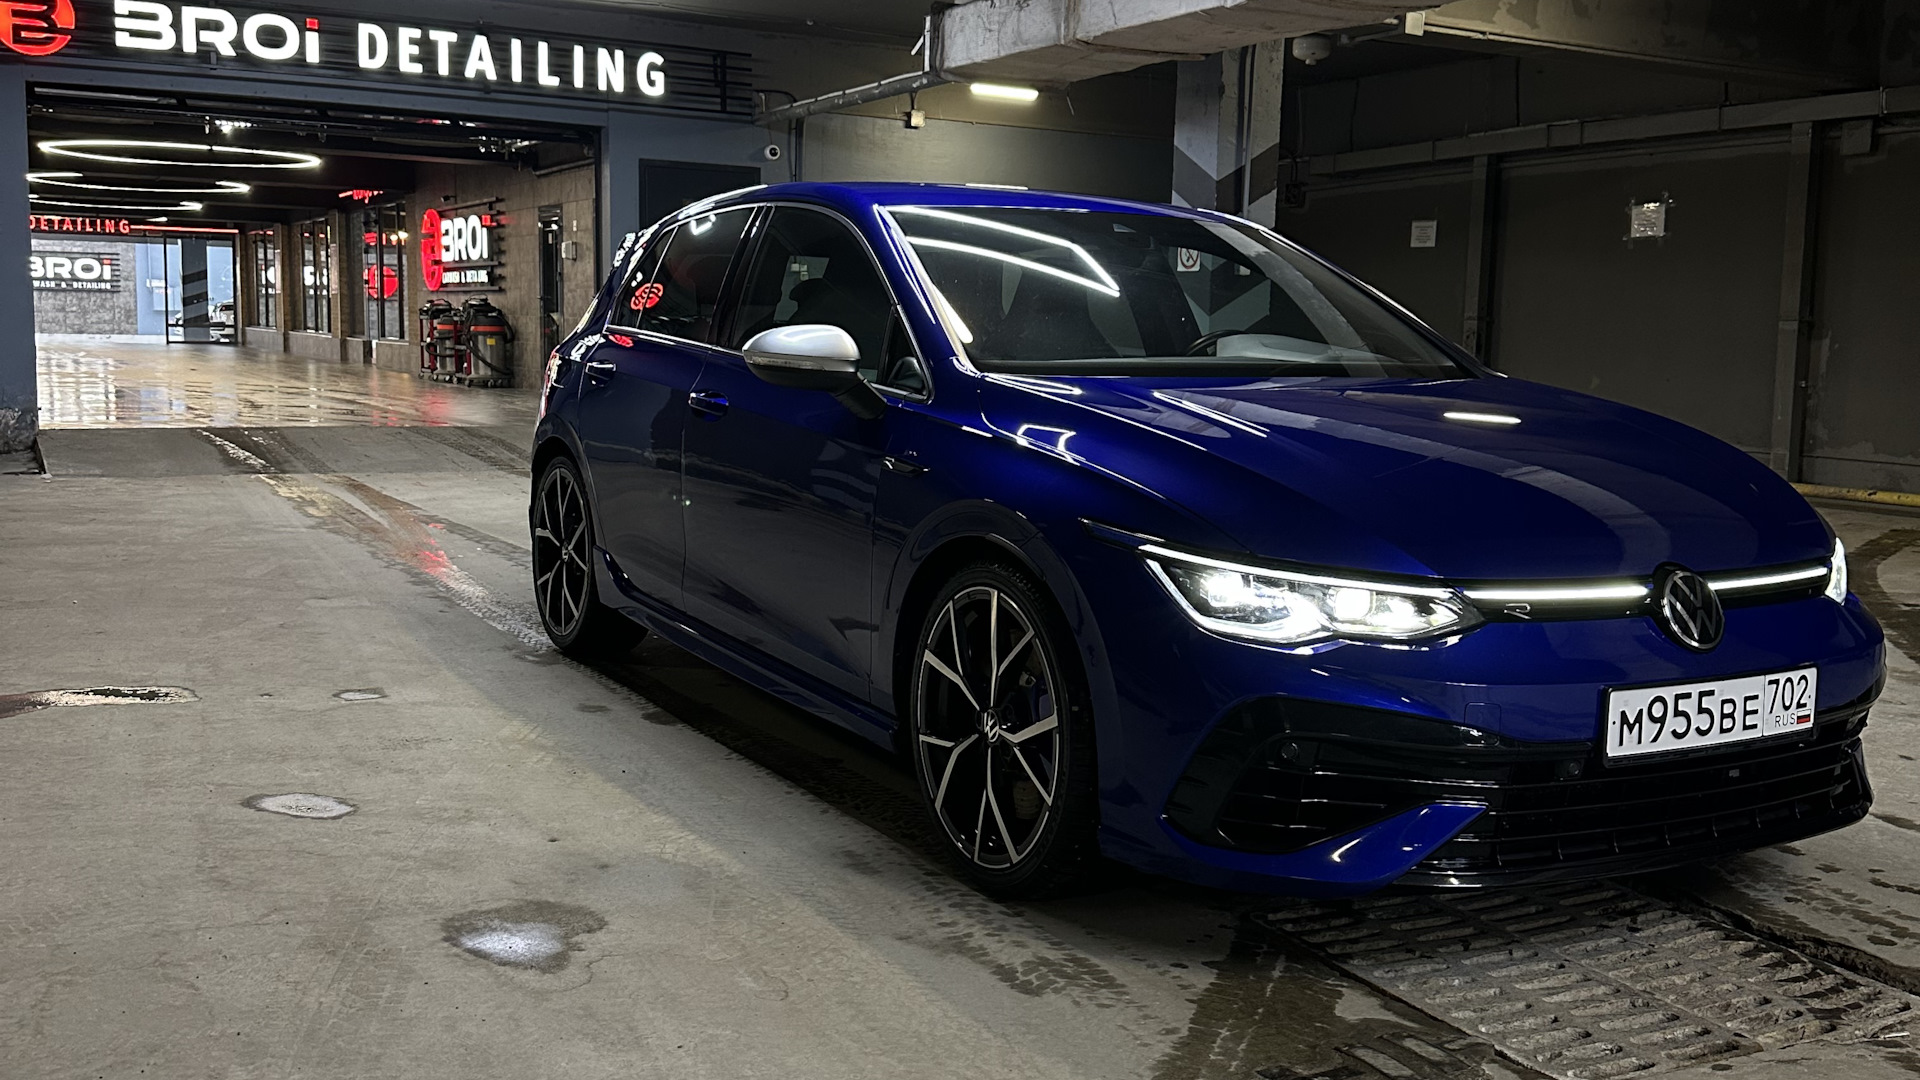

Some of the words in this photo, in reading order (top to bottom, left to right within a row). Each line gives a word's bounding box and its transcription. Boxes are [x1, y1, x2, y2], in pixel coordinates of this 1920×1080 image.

[357, 22, 666, 97] DETAILING
[1767, 674, 1809, 715] 702
[1774, 712, 1796, 728] RUS
